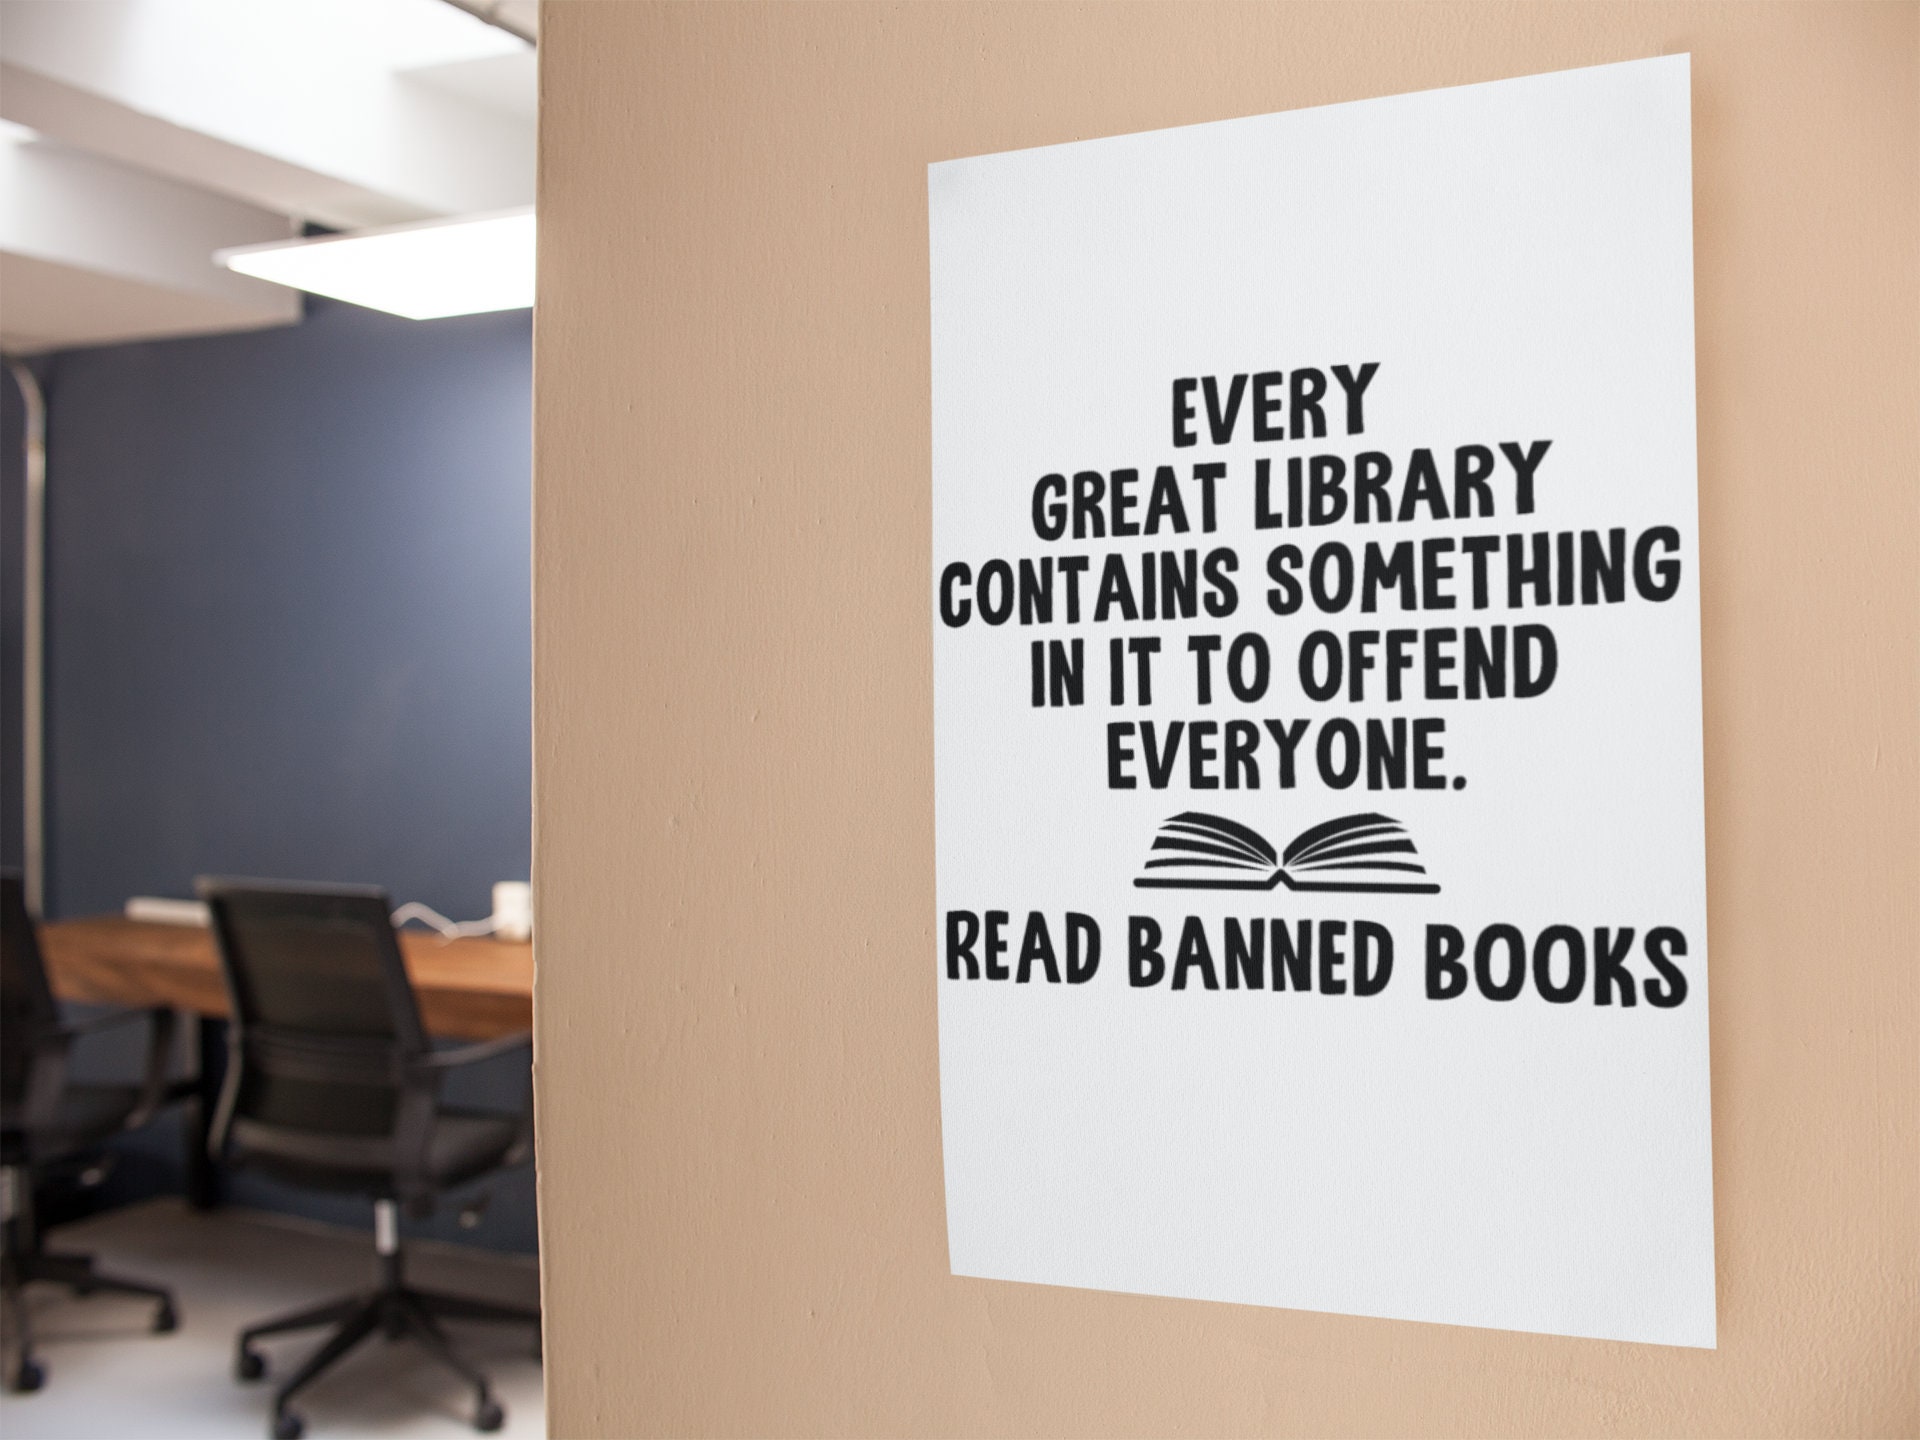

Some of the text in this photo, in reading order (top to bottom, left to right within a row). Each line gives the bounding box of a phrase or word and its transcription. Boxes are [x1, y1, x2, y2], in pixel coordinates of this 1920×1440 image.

[1172, 362, 1380, 449] EVERY
[1031, 440, 1552, 542] GREAT LIBRARY
[939, 525, 1681, 629] CONTAINS SOMETHING
[1031, 623, 1558, 708] IN IT TO OFFEND
[1107, 717, 1467, 791] EVERYONE.
[946, 909, 1688, 1009] READ BANNED BOOKS
